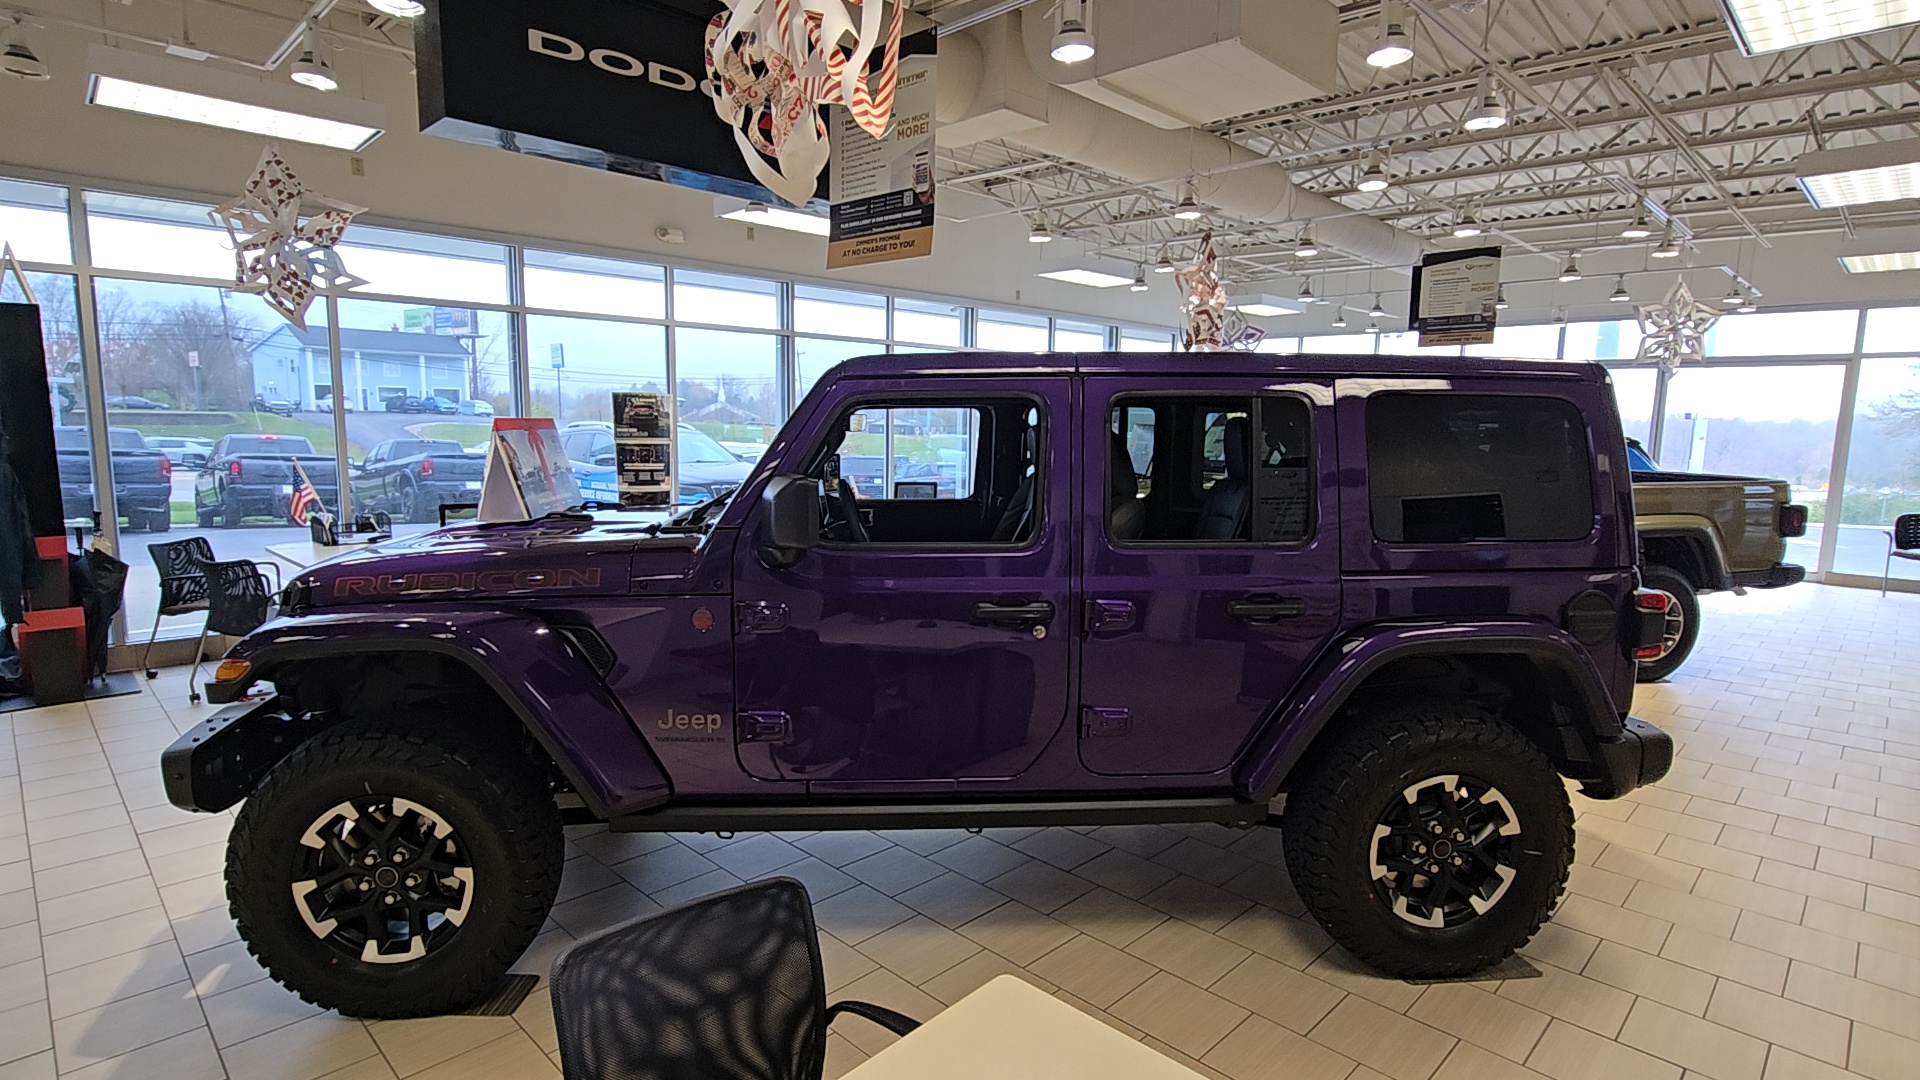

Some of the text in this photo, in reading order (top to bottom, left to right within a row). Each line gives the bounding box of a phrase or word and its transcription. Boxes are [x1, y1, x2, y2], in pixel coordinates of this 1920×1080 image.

[528, 28, 723, 99] DOD
[897, 116, 911, 127] AND
[911, 112, 930, 122] MUCH
[897, 121, 930, 141] MORE!
[878, 234, 901, 242] PROMISE
[842, 240, 916, 258] AT NO CHARGE TO YOU!
[333, 567, 601, 597] RUBICON
[657, 708, 722, 734] Jeep
